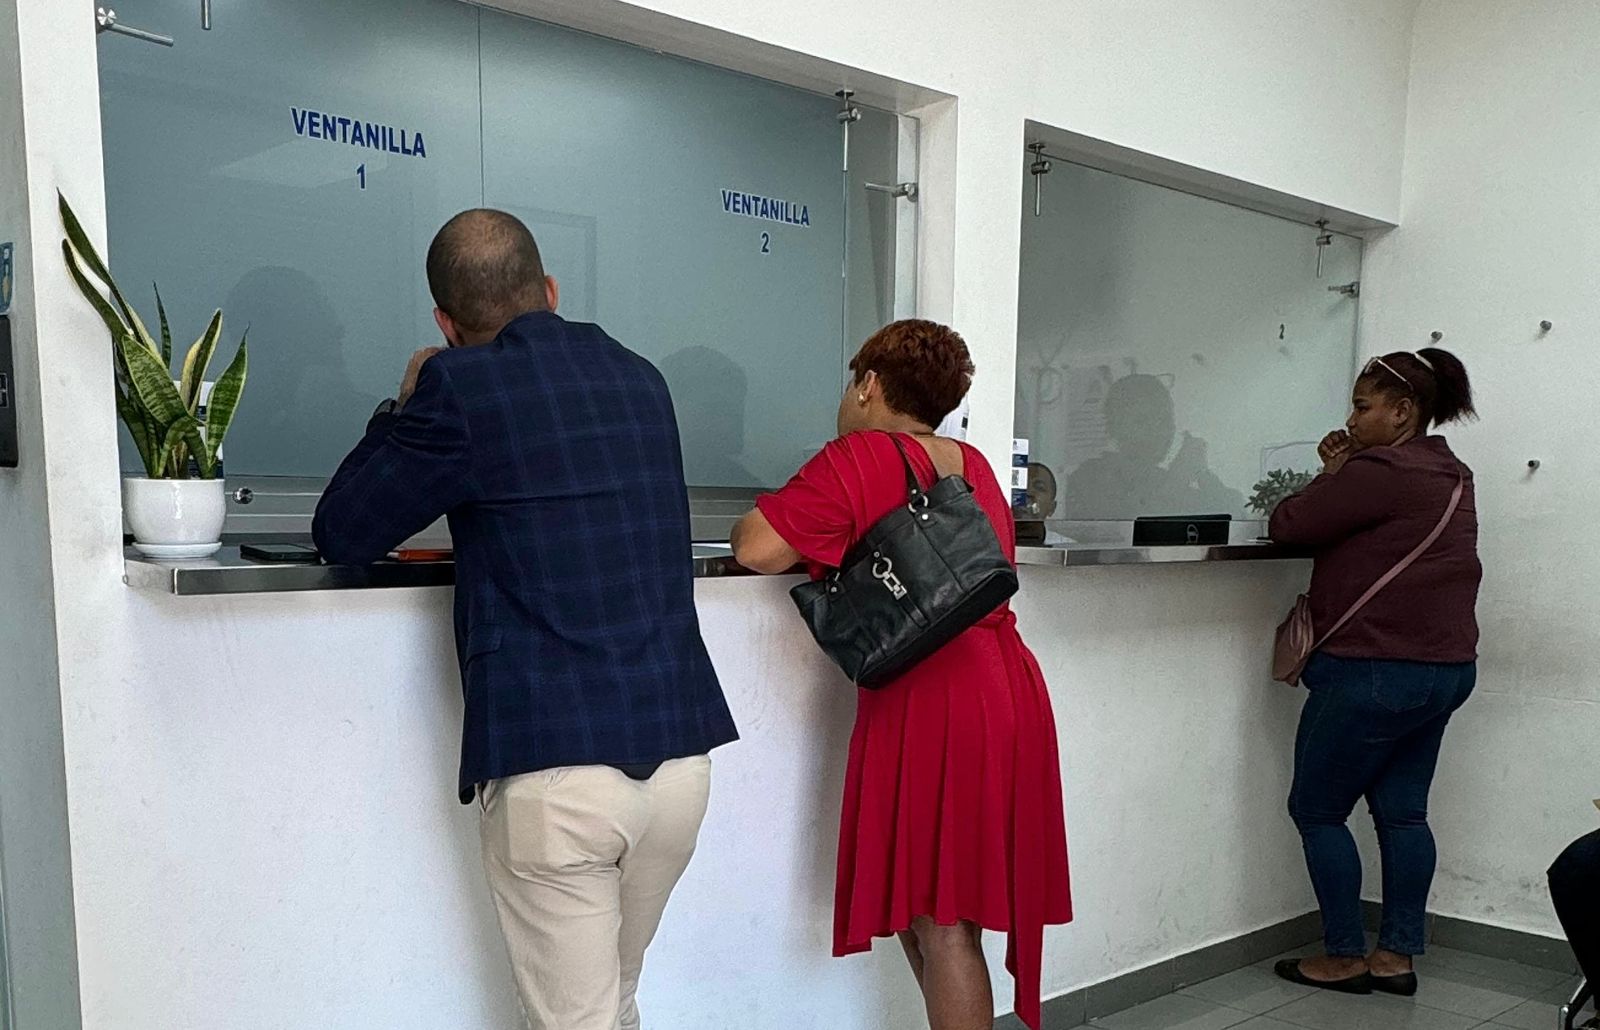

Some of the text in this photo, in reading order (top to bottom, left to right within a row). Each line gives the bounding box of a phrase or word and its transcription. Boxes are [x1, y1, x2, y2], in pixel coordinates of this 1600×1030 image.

[291, 107, 426, 158] VENTANILLA
[356, 163, 366, 189] 1
[721, 189, 810, 226] VENTANILLA
[761, 232, 770, 253] 2
